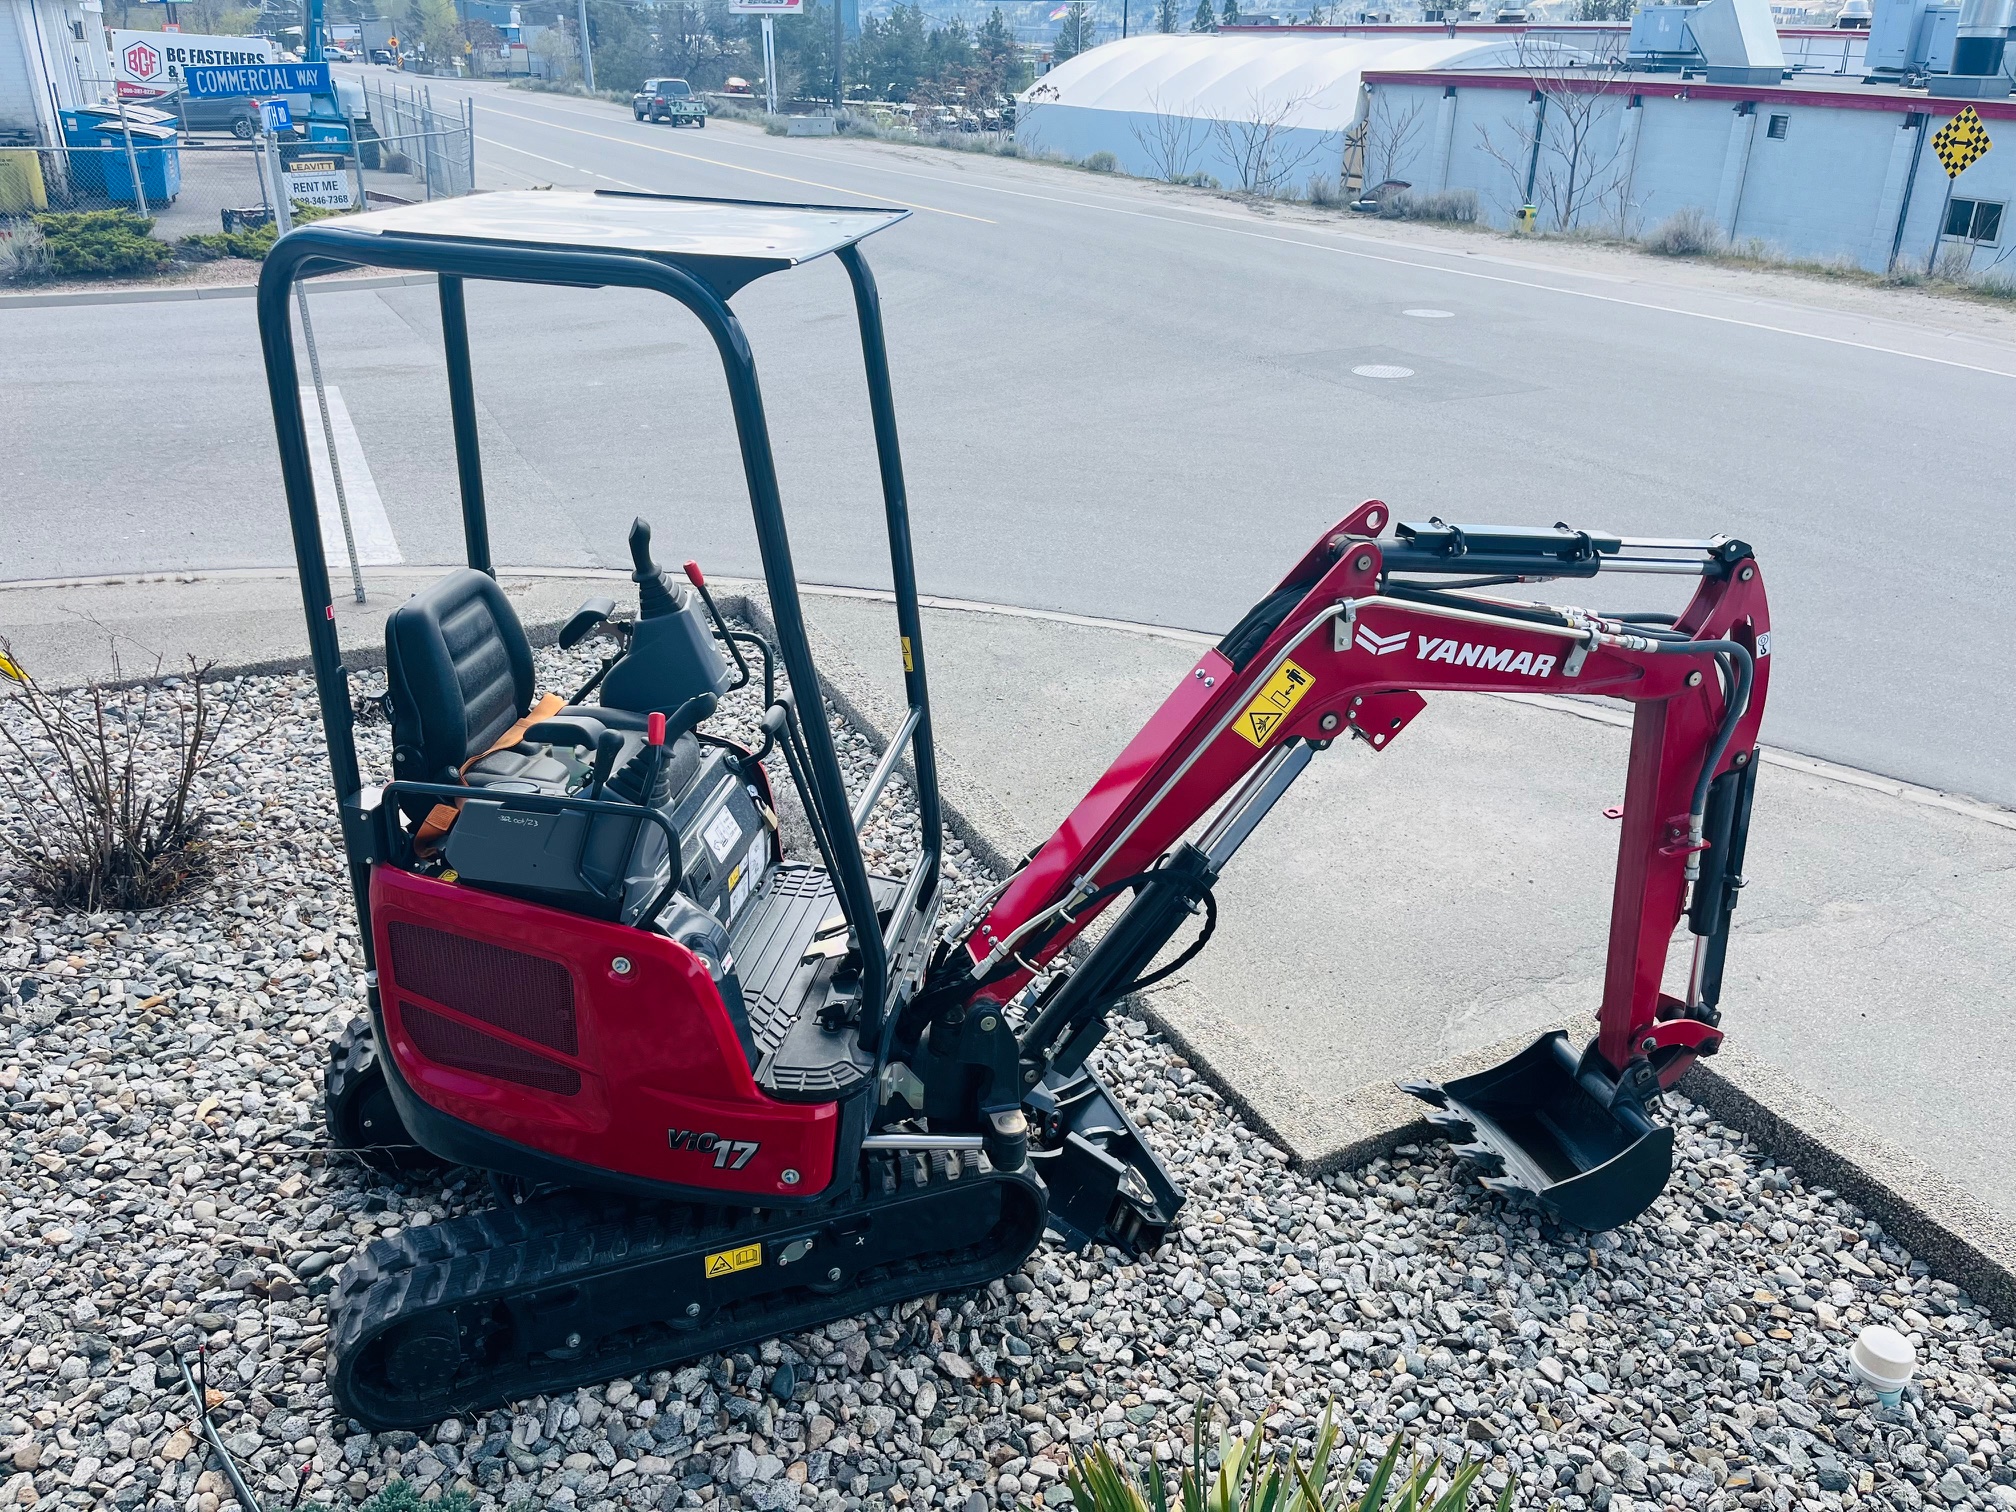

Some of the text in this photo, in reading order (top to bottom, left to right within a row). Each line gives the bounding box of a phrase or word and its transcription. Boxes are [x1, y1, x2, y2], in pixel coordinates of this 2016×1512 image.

[166, 47, 265, 66] BC FASTENERS
[168, 65, 179, 78] &
[195, 68, 293, 94] COMMERCIAL
[296, 69, 318, 86] WAY
[291, 162, 333, 172] LEAVITT
[293, 180, 339, 193] RENT ME
[1416, 635, 1557, 678] YANMAR
